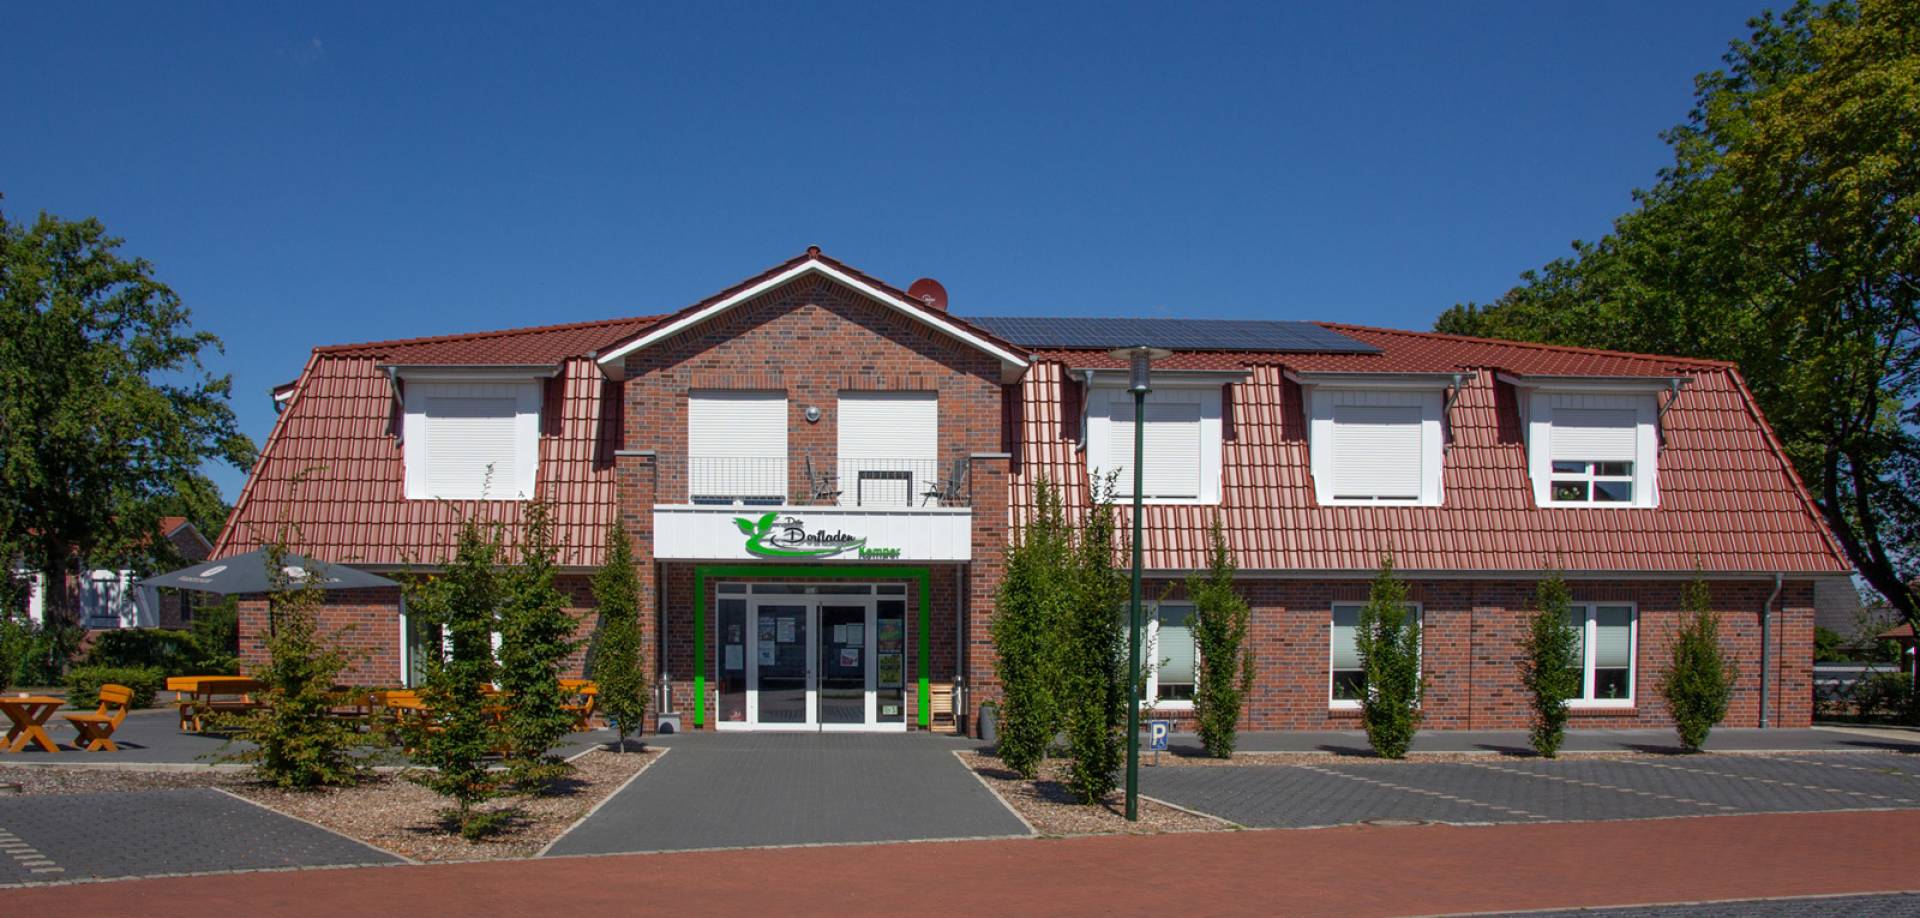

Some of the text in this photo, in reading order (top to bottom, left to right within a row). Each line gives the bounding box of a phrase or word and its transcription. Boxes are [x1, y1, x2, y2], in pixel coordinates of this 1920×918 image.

[771, 527, 856, 546] Dorfladen
[859, 546, 900, 558] Kemper
[1153, 724, 1166, 745] P
